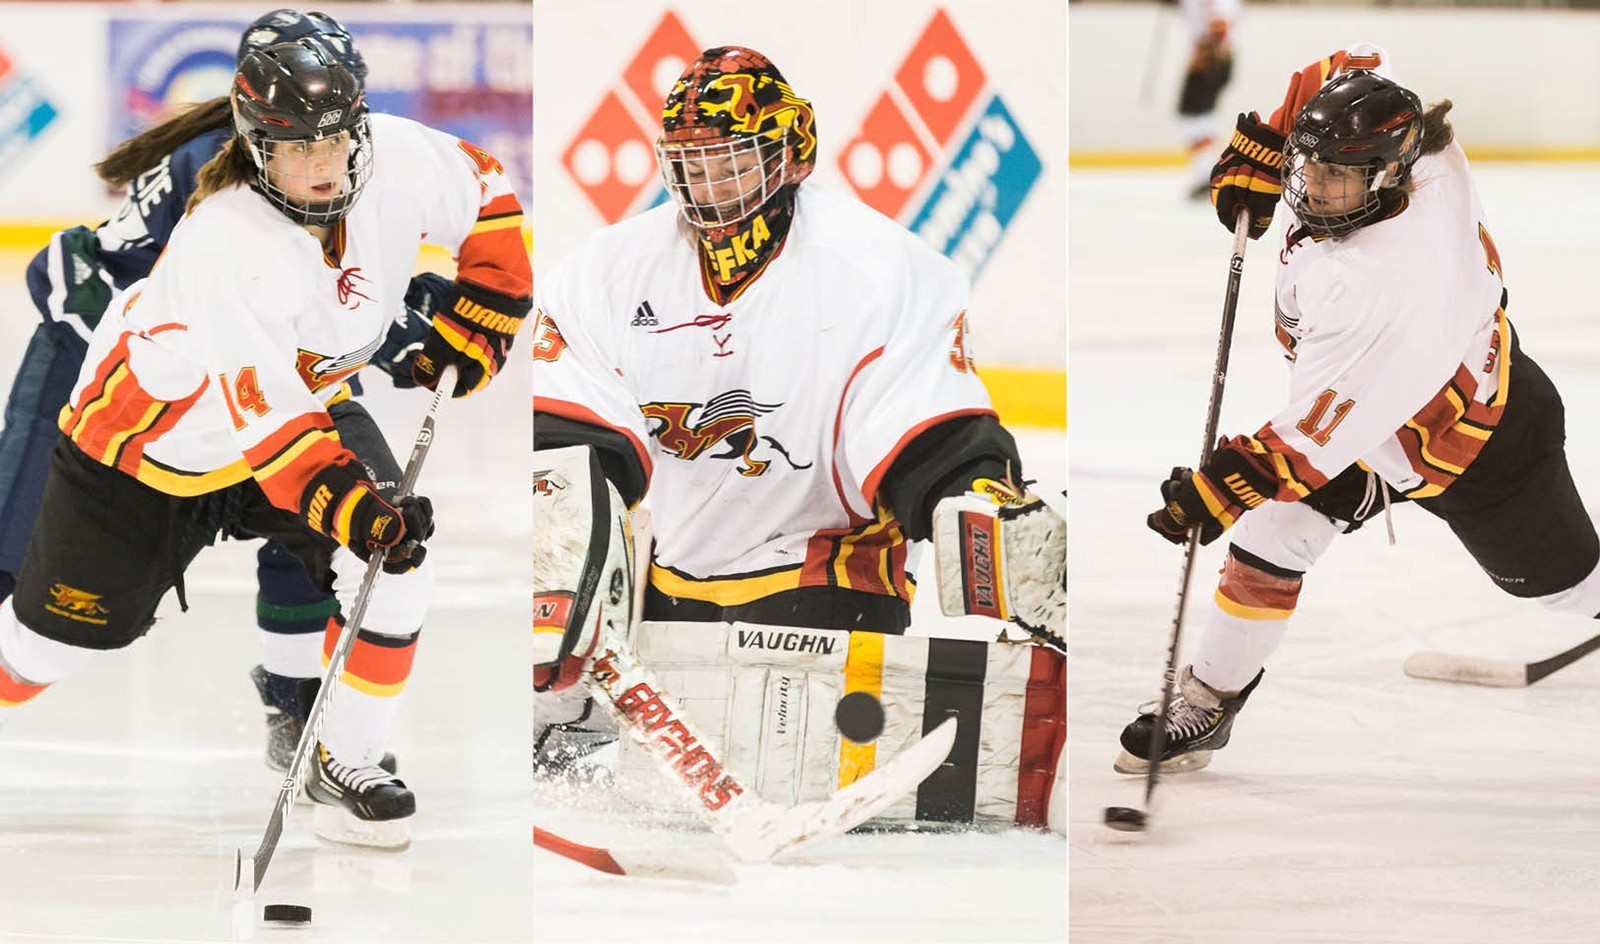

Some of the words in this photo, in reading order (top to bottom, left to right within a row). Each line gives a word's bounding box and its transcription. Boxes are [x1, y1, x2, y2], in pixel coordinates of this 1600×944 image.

[218, 366, 272, 432] 14
[1296, 388, 1356, 447] 11
[972, 524, 994, 608] VAUGHN
[738, 630, 836, 655] VAUGHN
[616, 682, 744, 812] GRYPHONS
